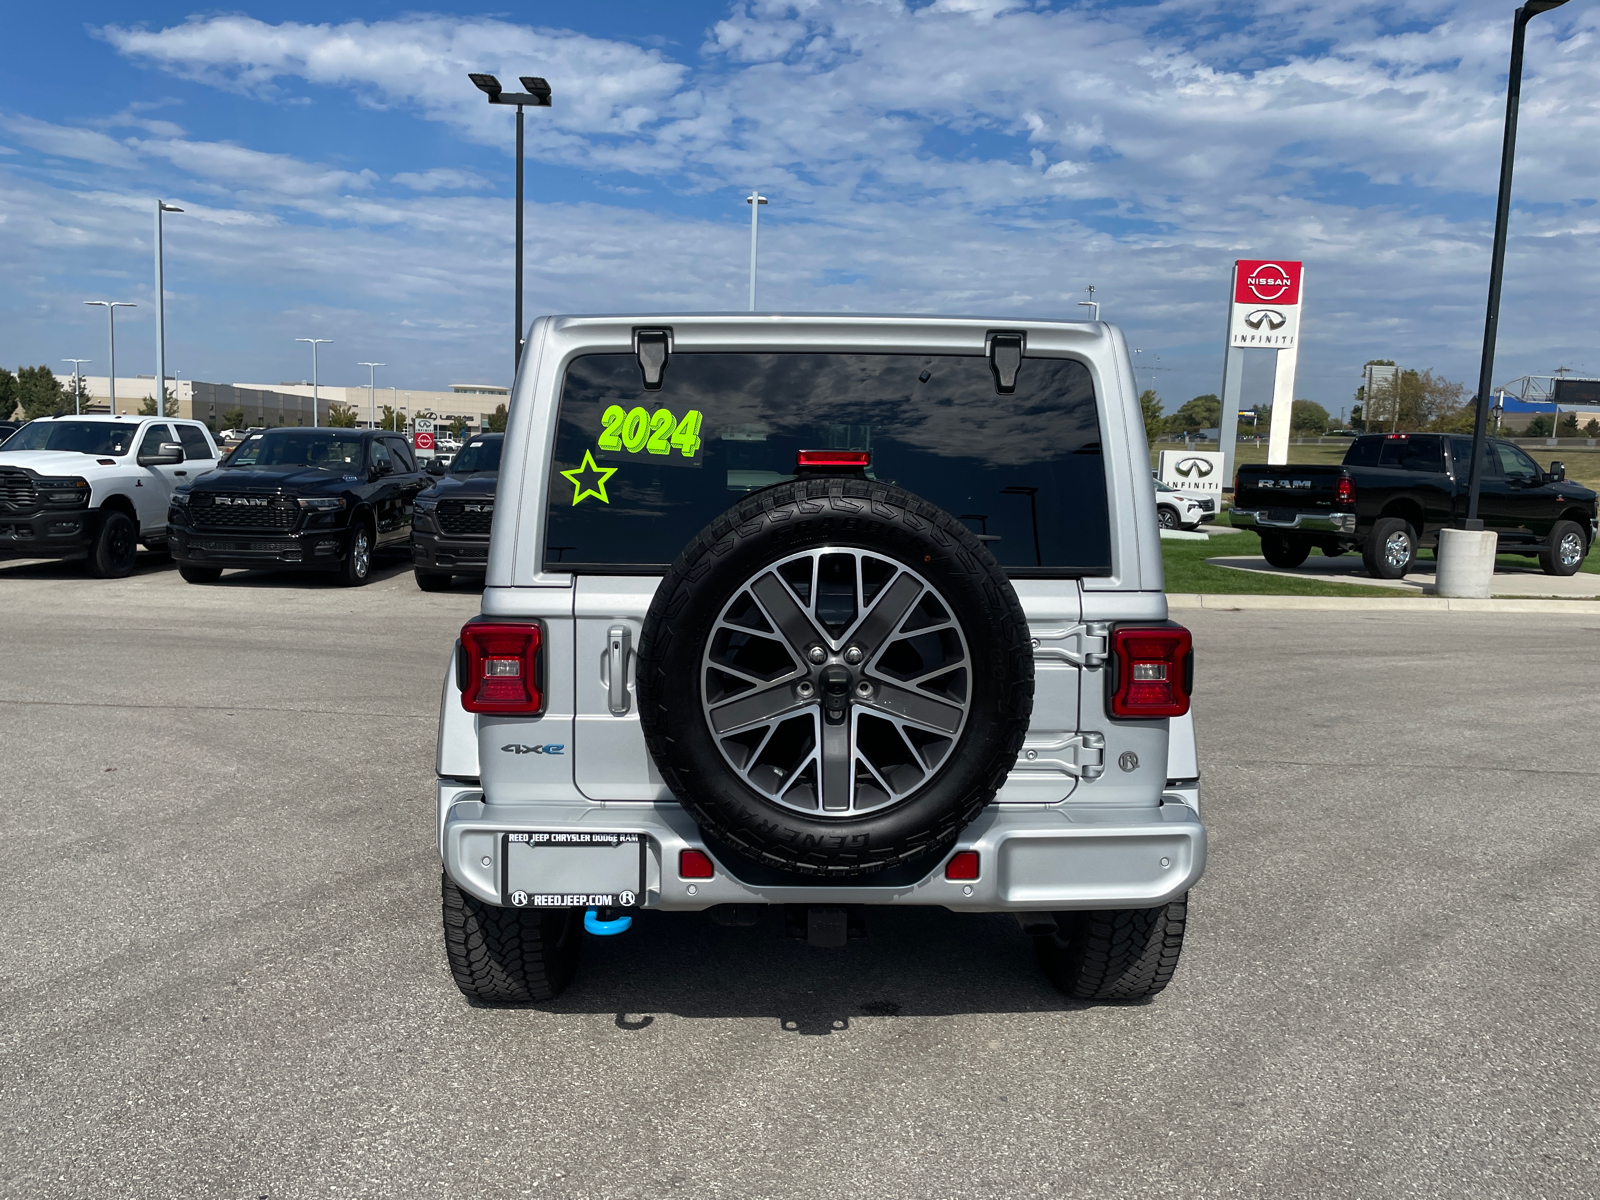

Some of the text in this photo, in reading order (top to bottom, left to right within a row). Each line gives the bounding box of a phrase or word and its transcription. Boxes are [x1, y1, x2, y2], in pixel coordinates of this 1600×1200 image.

[1247, 277, 1291, 286] NISSAN
[1233, 334, 1294, 344] INFINITI
[597, 404, 703, 458] 2024
[1166, 481, 1218, 490] INFINITI
[1258, 479, 1312, 489] RAM
[215, 497, 268, 506] RAM
[464, 504, 494, 512] RA
[772, 515, 931, 552] GRABBER
[721, 789, 871, 850] GENERAL
[508, 833, 639, 842] REED JEEP CHRYSLER DODGE RAM
[533, 894, 613, 906] REEDJEEP.COM
